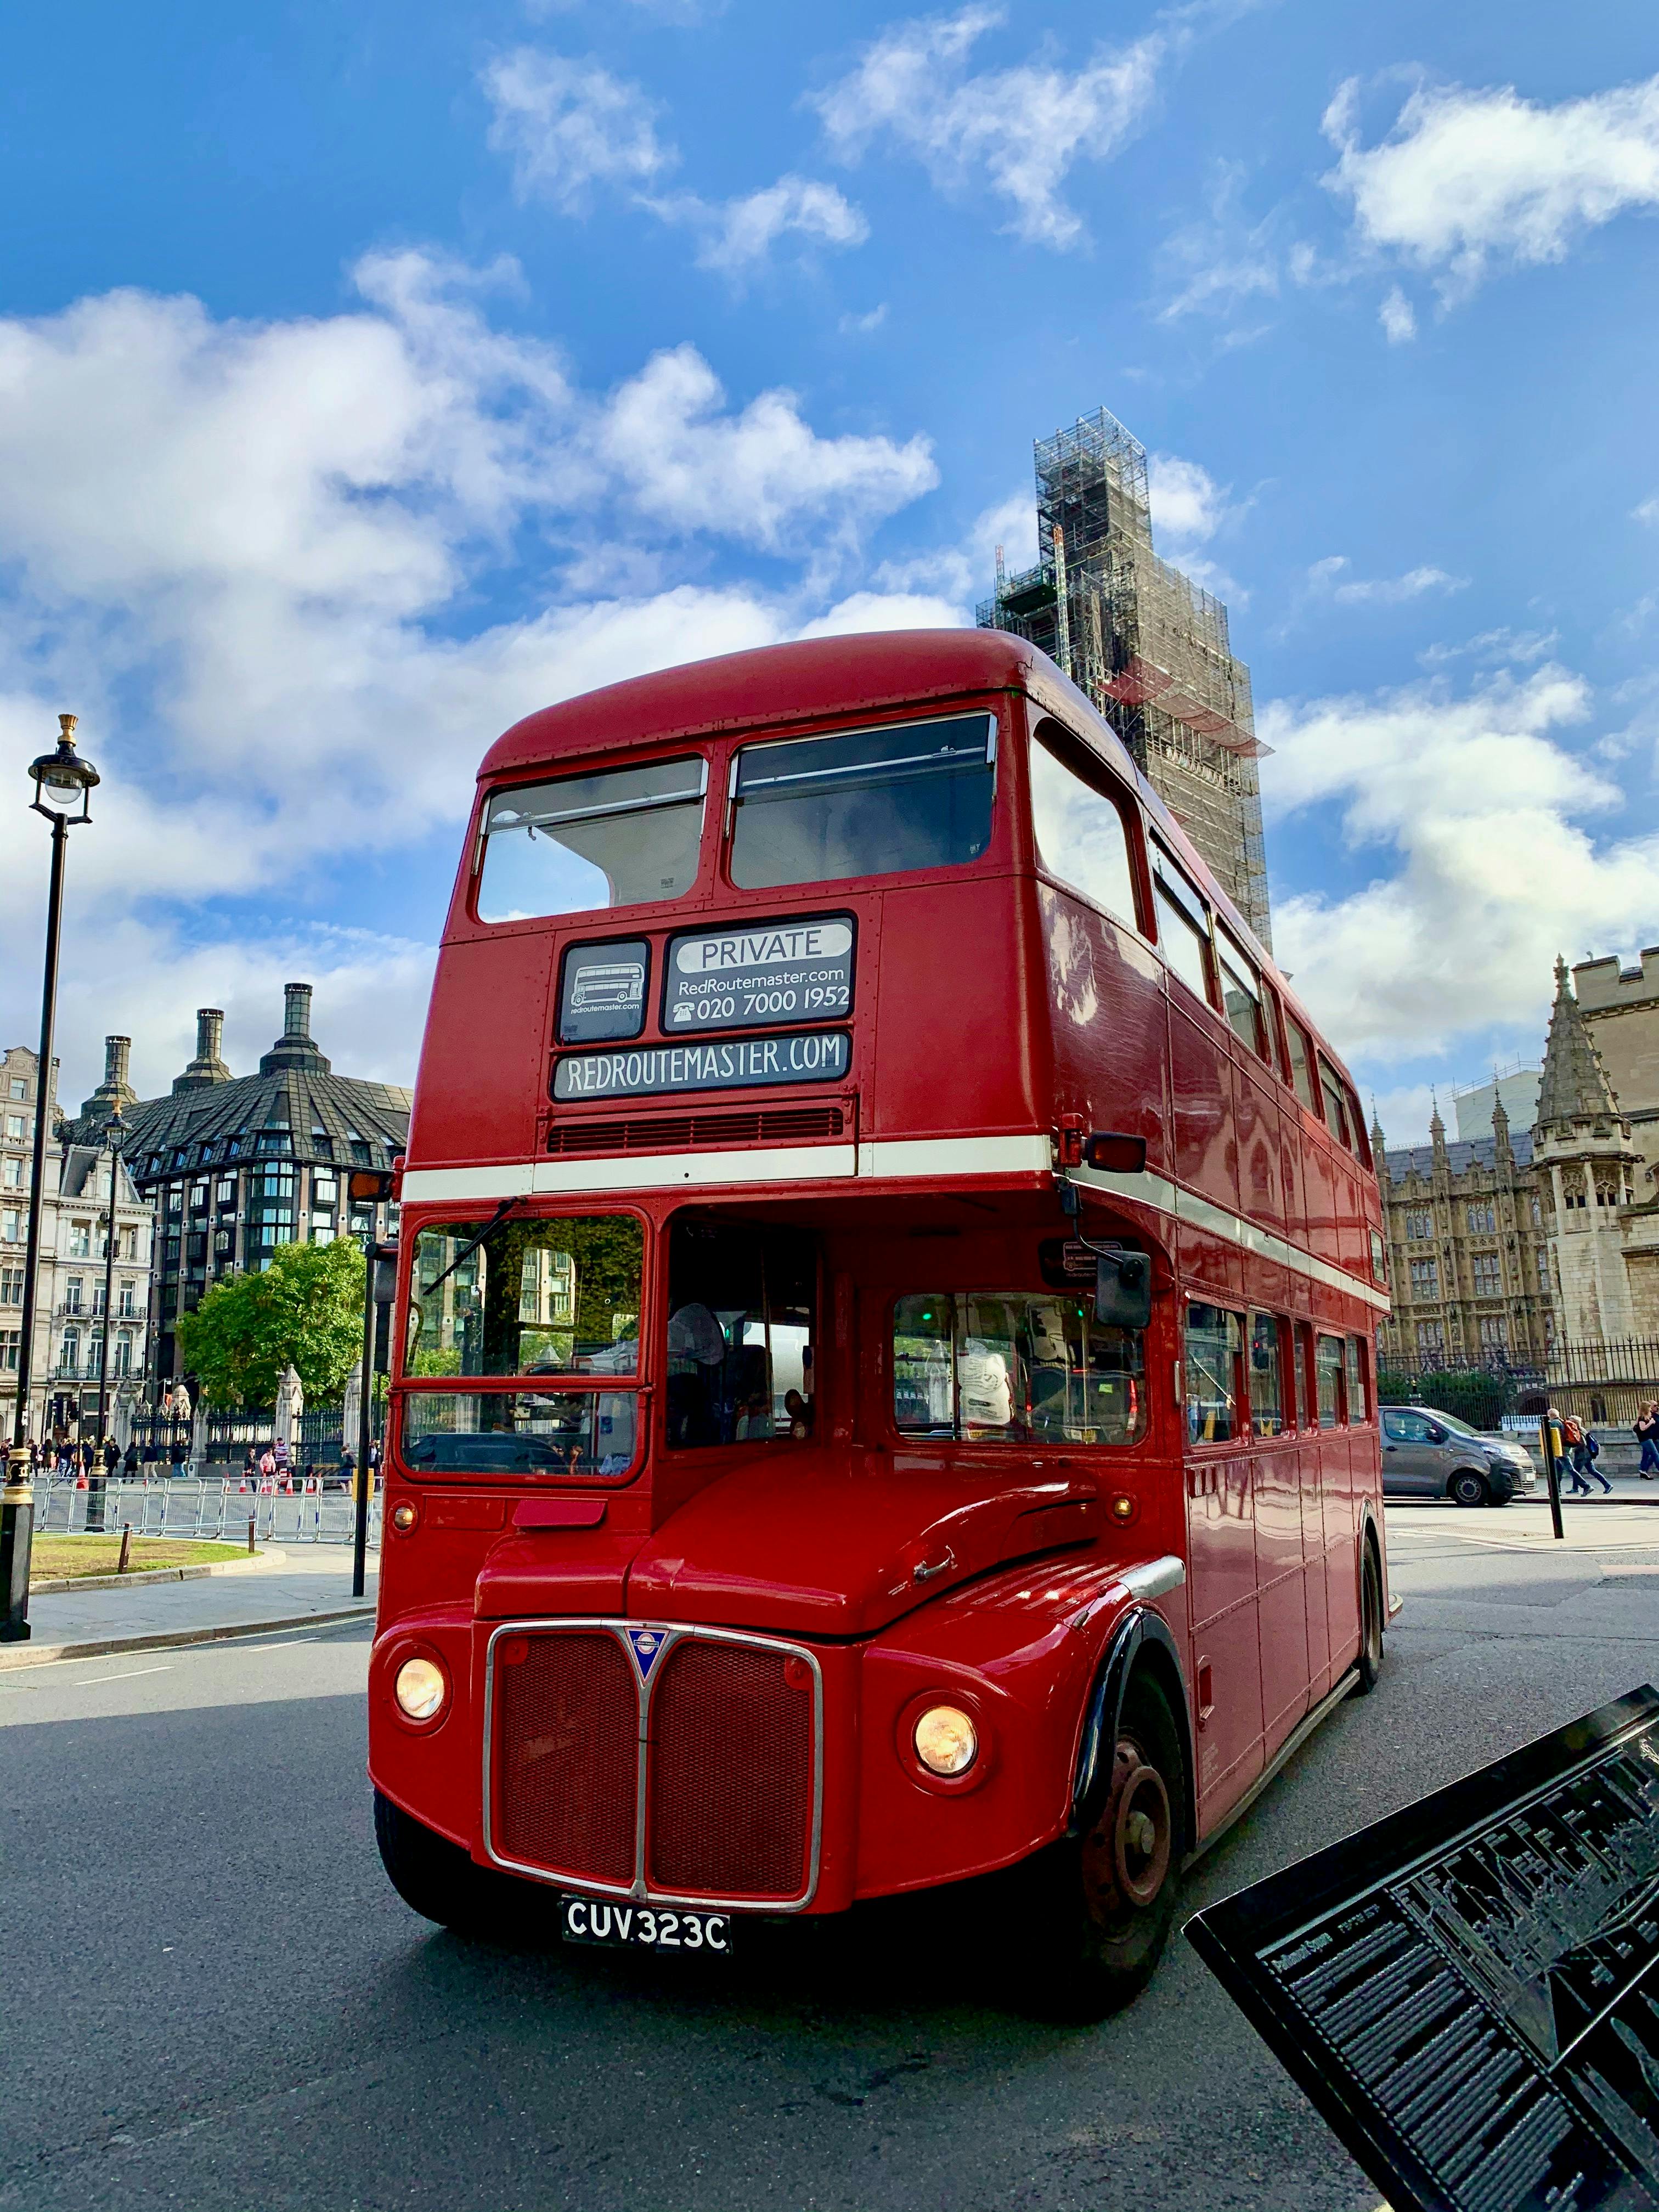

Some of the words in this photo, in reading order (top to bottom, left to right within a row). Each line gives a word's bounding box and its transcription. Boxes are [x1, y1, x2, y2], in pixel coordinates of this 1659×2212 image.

[702, 929, 822, 969] PRIVATE
[678, 968, 845, 997] RedRoutemaster.com
[571, 1003, 640, 1014] redroutemaster.com
[697, 996, 736, 1020] 020
[743, 990, 797, 1015] 7000
[804, 984, 850, 1009] 1952
[567, 1035, 840, 1092] REDROUTEMASTER.COM
[567, 1901, 727, 1950] CUV323C
